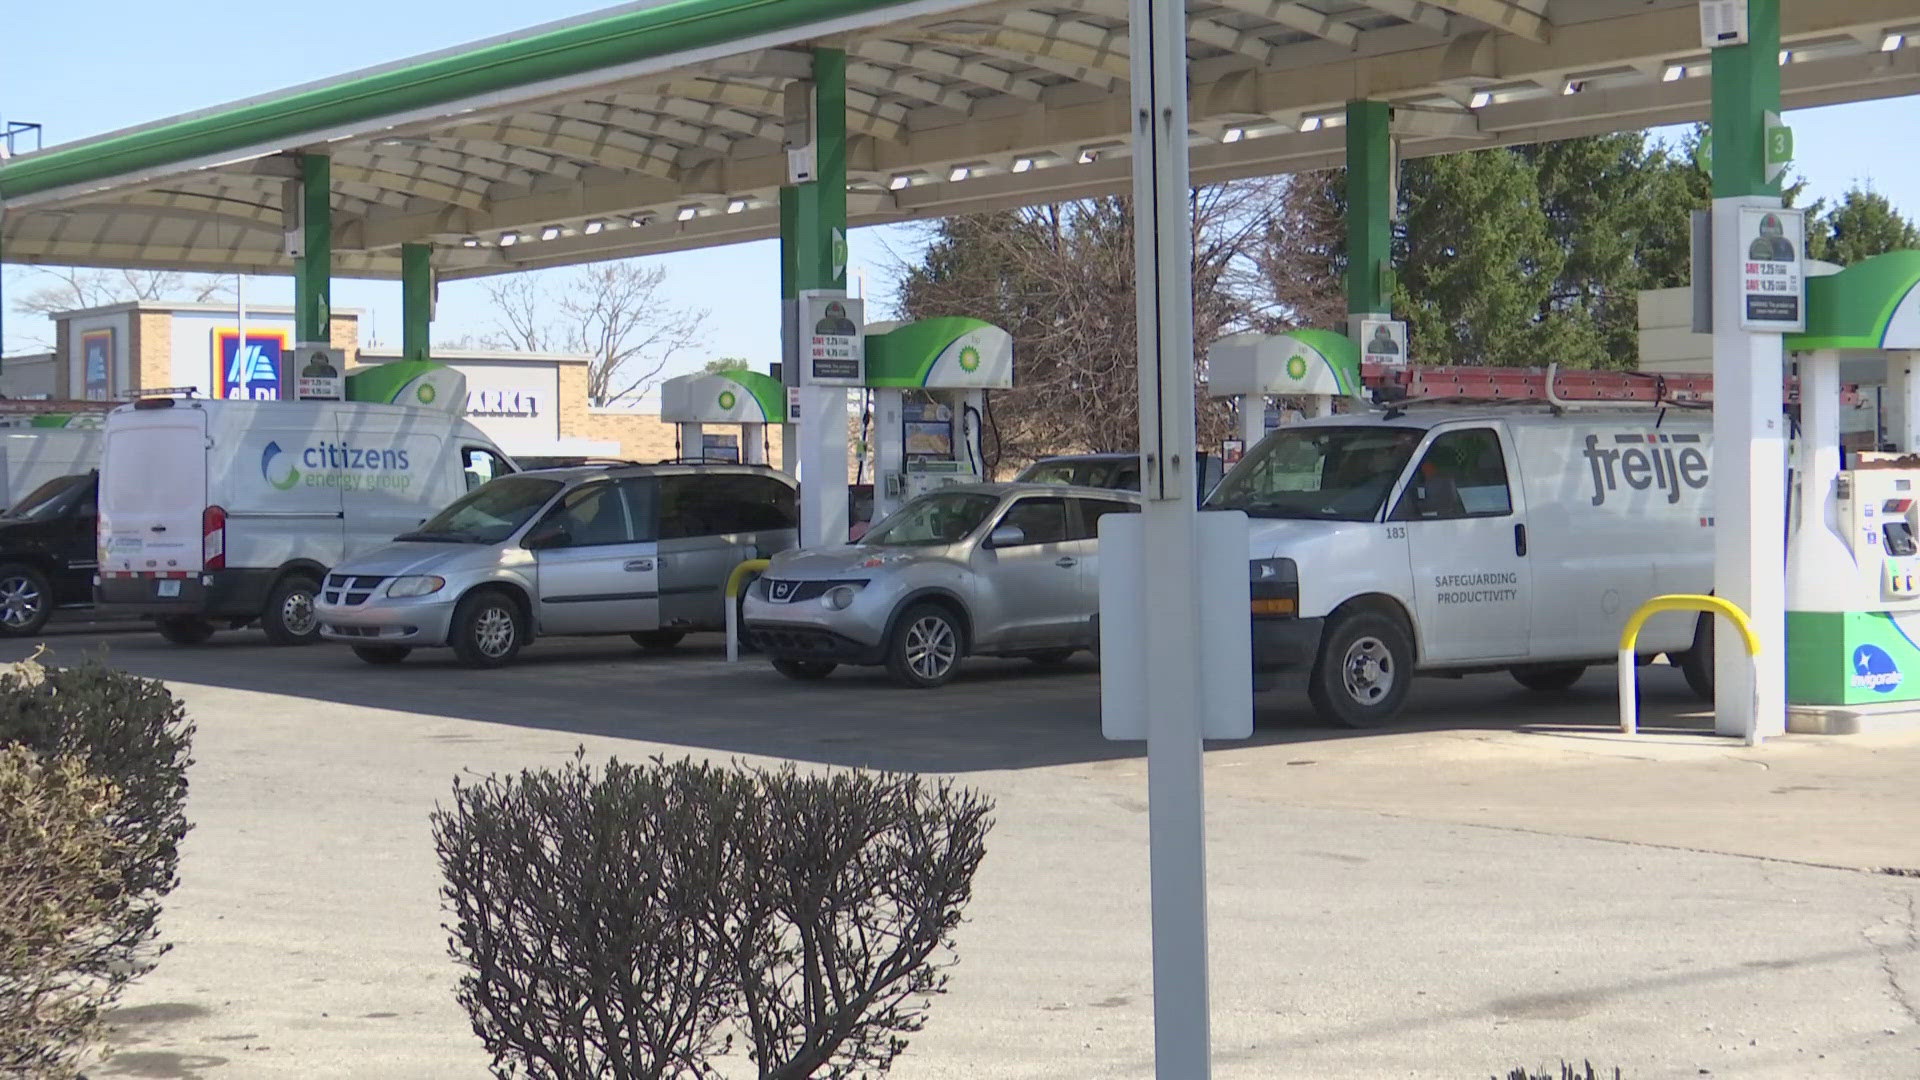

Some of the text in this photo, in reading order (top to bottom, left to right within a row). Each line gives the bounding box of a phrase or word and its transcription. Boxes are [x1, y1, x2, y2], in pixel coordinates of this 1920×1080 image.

[1774, 133, 1785, 154] 3
[466, 389, 547, 415] ARKET
[303, 441, 409, 470] citizens
[305, 474, 411, 493] energy group
[1386, 527, 1406, 539] 183
[1435, 573, 1517, 588] SAFEGUARDING
[1437, 590, 1517, 604] PRODUCTIVITY
